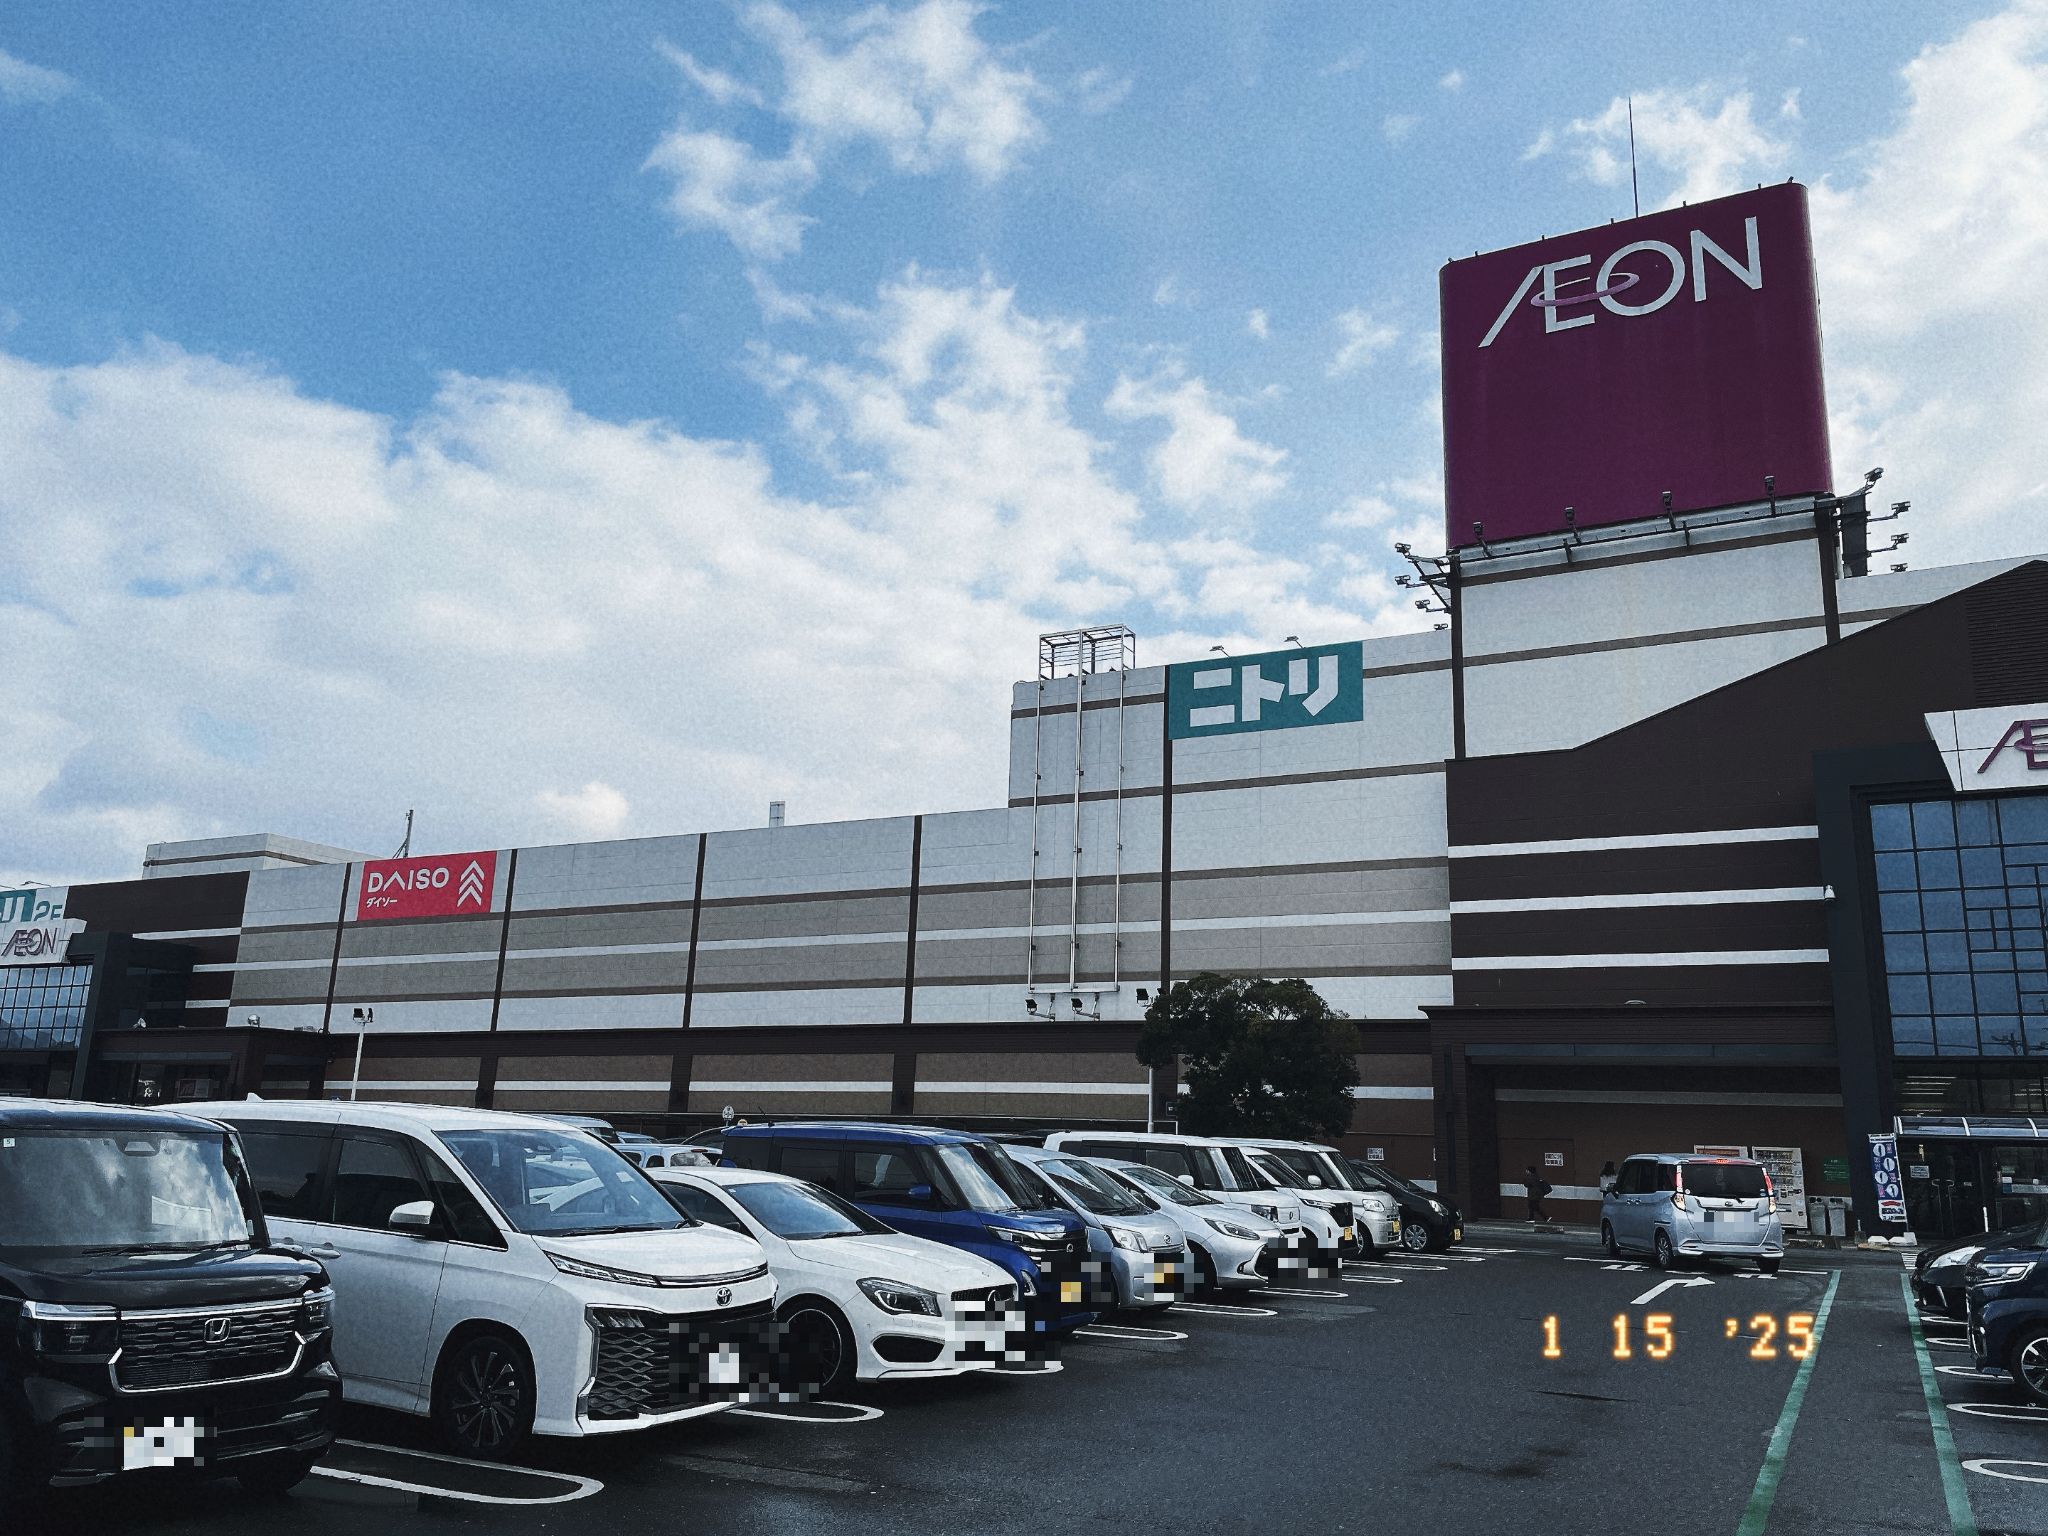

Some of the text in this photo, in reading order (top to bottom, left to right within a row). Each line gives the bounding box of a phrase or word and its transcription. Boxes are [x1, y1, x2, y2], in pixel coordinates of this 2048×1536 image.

[1190, 655, 1339, 728] ニトリ
[367, 867, 450, 893] DAISO
[366, 896, 398, 908] ダイソー
